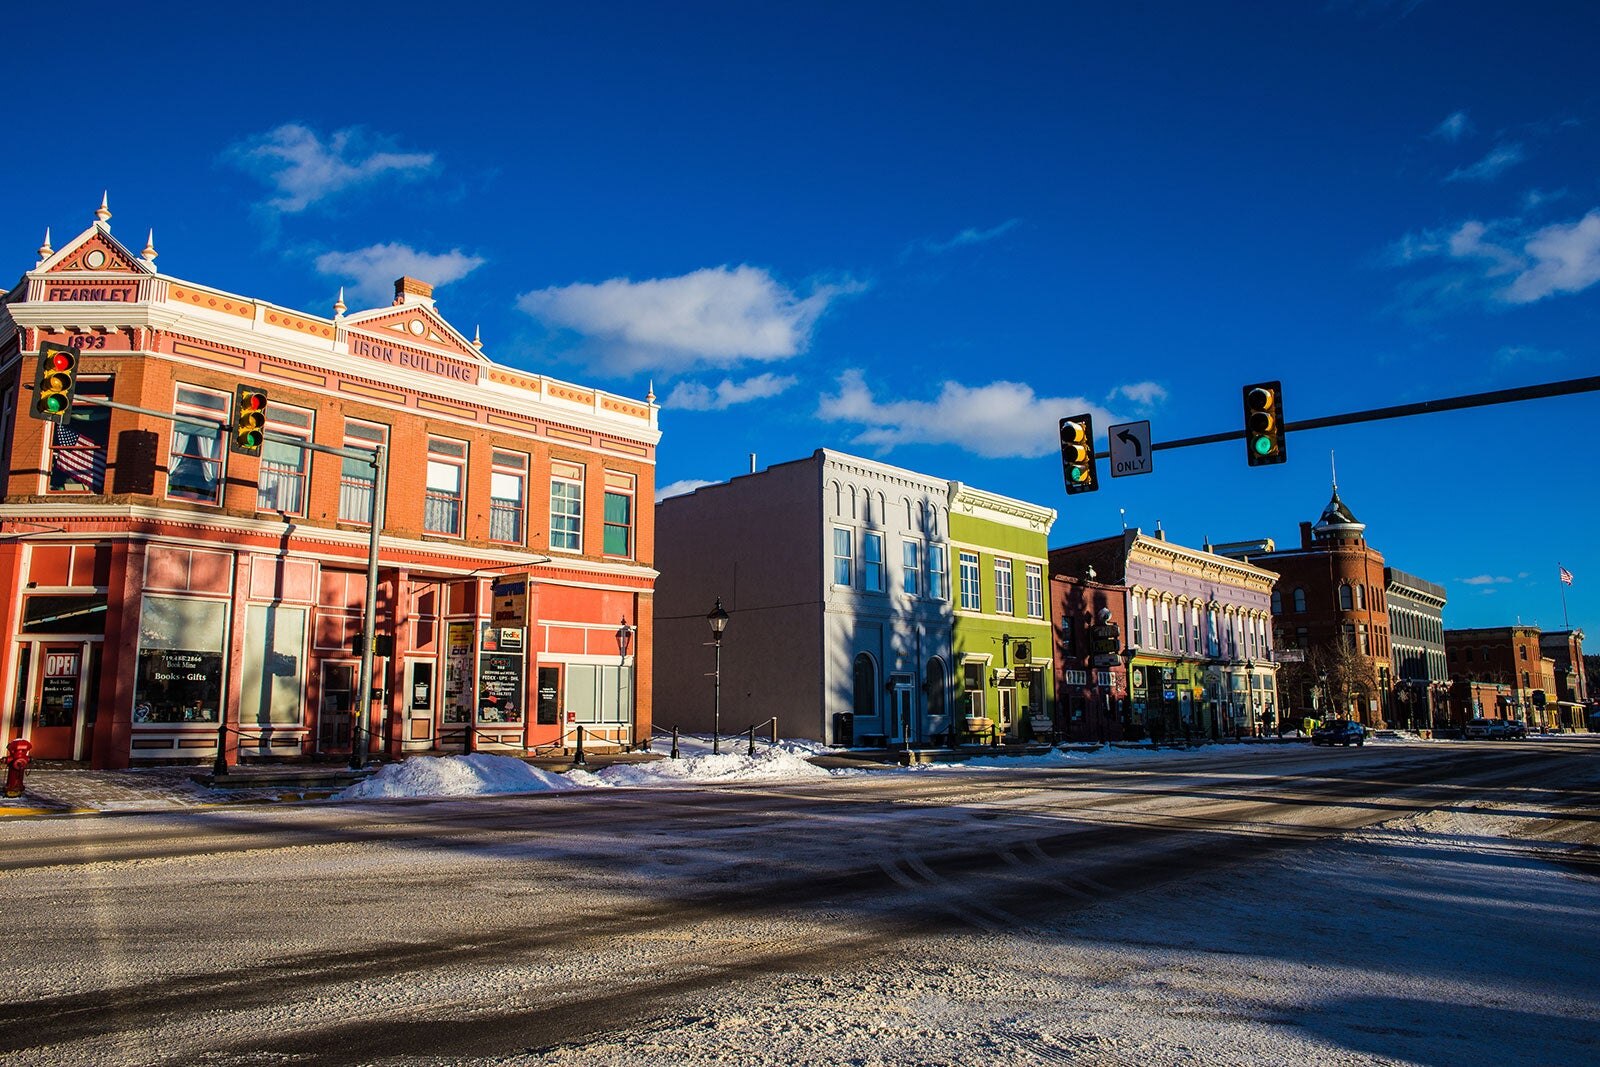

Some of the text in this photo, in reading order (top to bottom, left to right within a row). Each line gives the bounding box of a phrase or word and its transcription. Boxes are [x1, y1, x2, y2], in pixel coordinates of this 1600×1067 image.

[50, 288, 132, 302] FEARNLEY
[68, 334, 106, 350] 1893
[353, 339, 471, 382] IRON BUILDING
[1116, 458, 1146, 473] ONLY
[502, 631, 520, 639] FedEx
[47, 655, 78, 676] OPEN
[155, 672, 207, 681] Books Gifts
